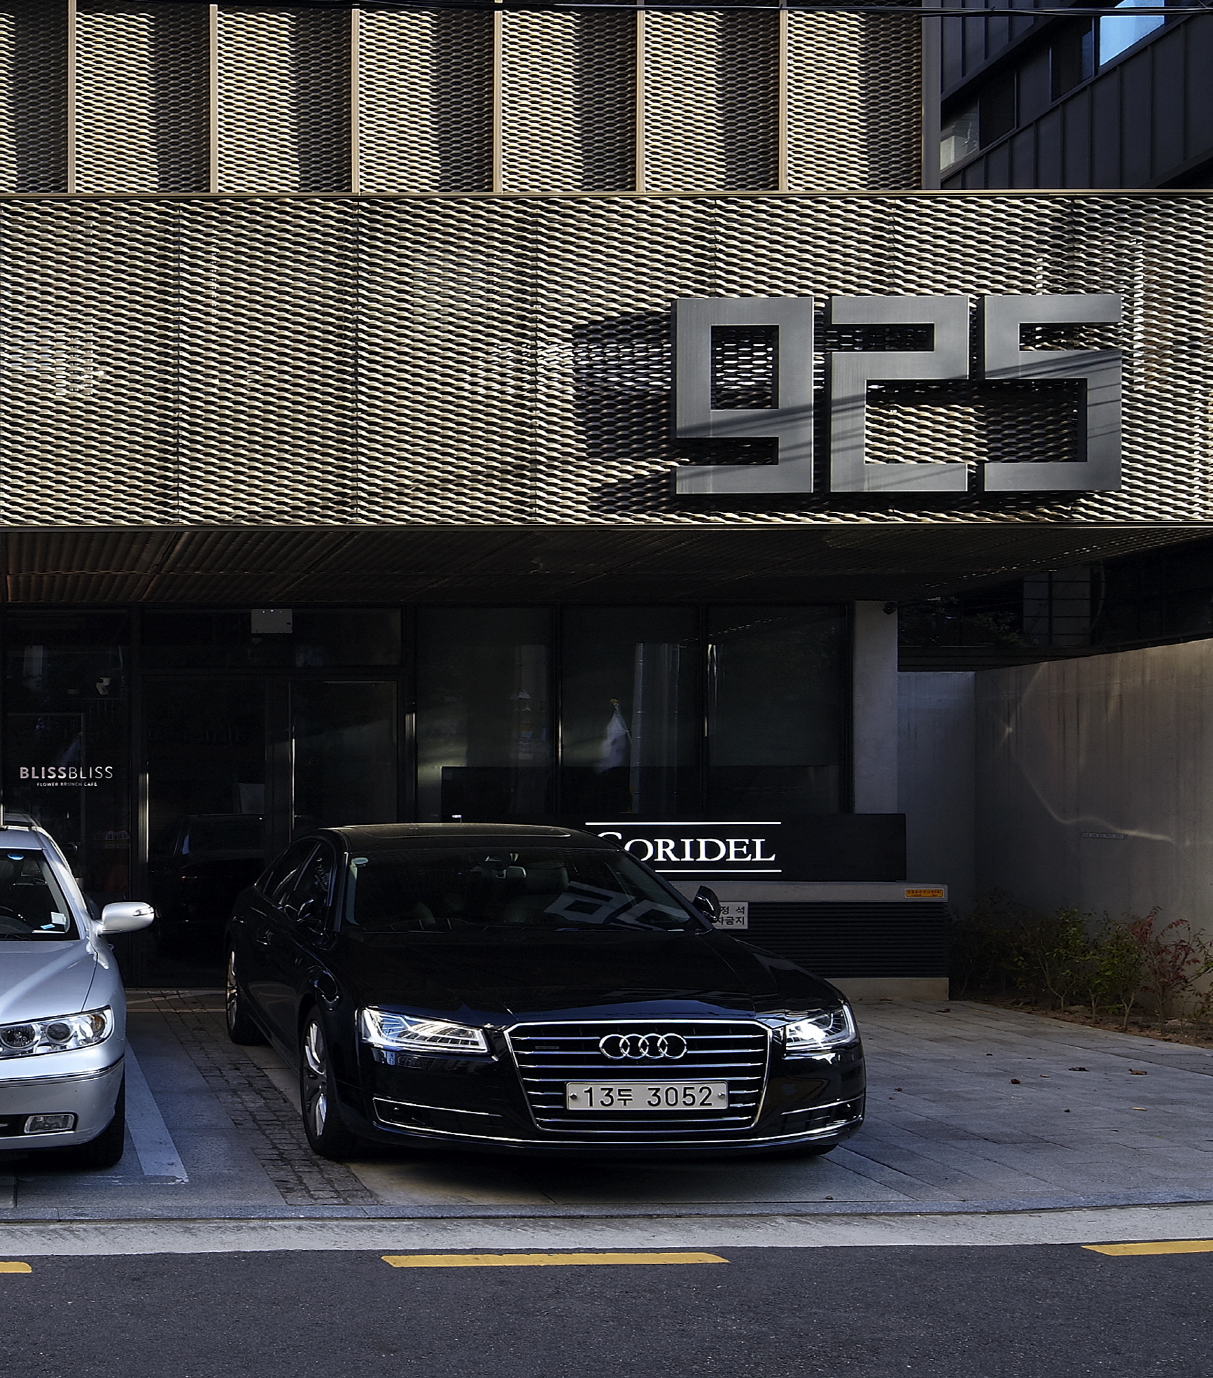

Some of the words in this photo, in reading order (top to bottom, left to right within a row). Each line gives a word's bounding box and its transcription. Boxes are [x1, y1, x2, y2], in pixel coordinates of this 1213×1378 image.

[676, 294, 1122, 494] 925
[19, 766, 113, 779] BLISSBLISS
[584, 1086, 633, 1107] 13두
[647, 1086, 713, 1107] 3052
